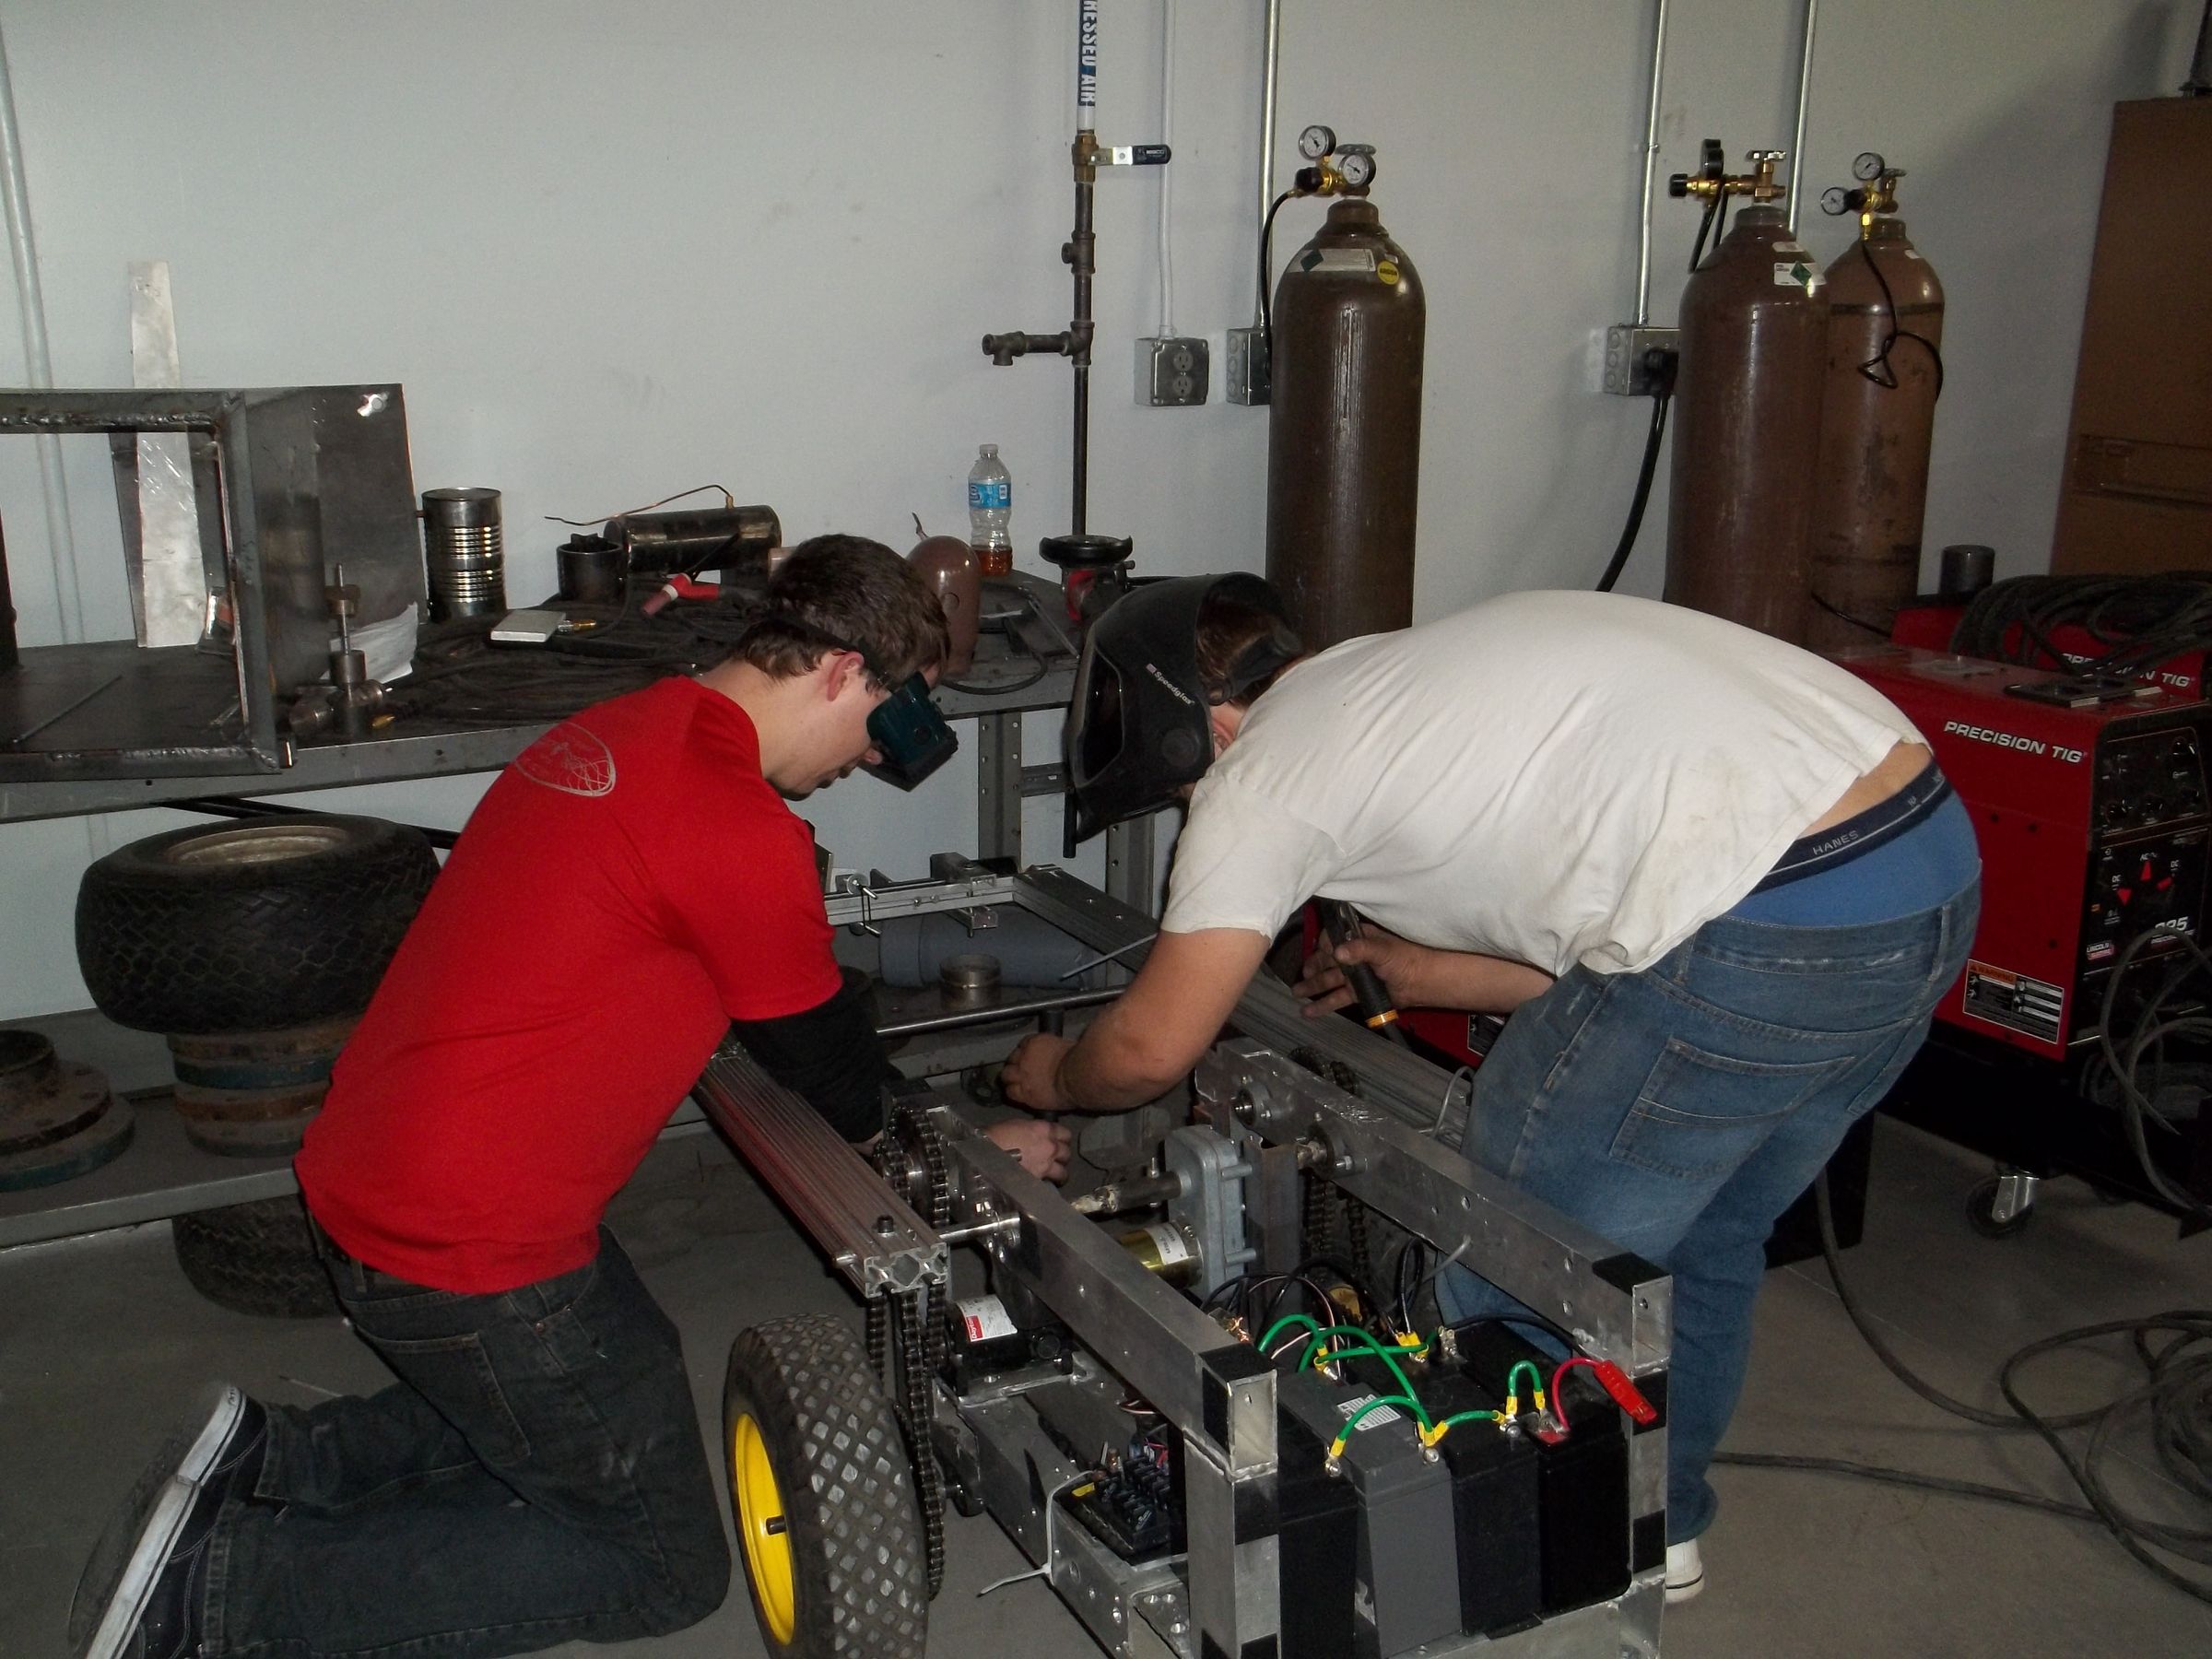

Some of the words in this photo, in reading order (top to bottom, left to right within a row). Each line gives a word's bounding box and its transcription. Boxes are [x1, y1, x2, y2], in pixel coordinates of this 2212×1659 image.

[1080, 74, 1096, 102] AIR
[2161, 671, 2191, 688] TIG
[1943, 720, 2046, 756] PRECISION
[2052, 744, 2084, 764] TIG
[1812, 830, 1860, 856] HANES
